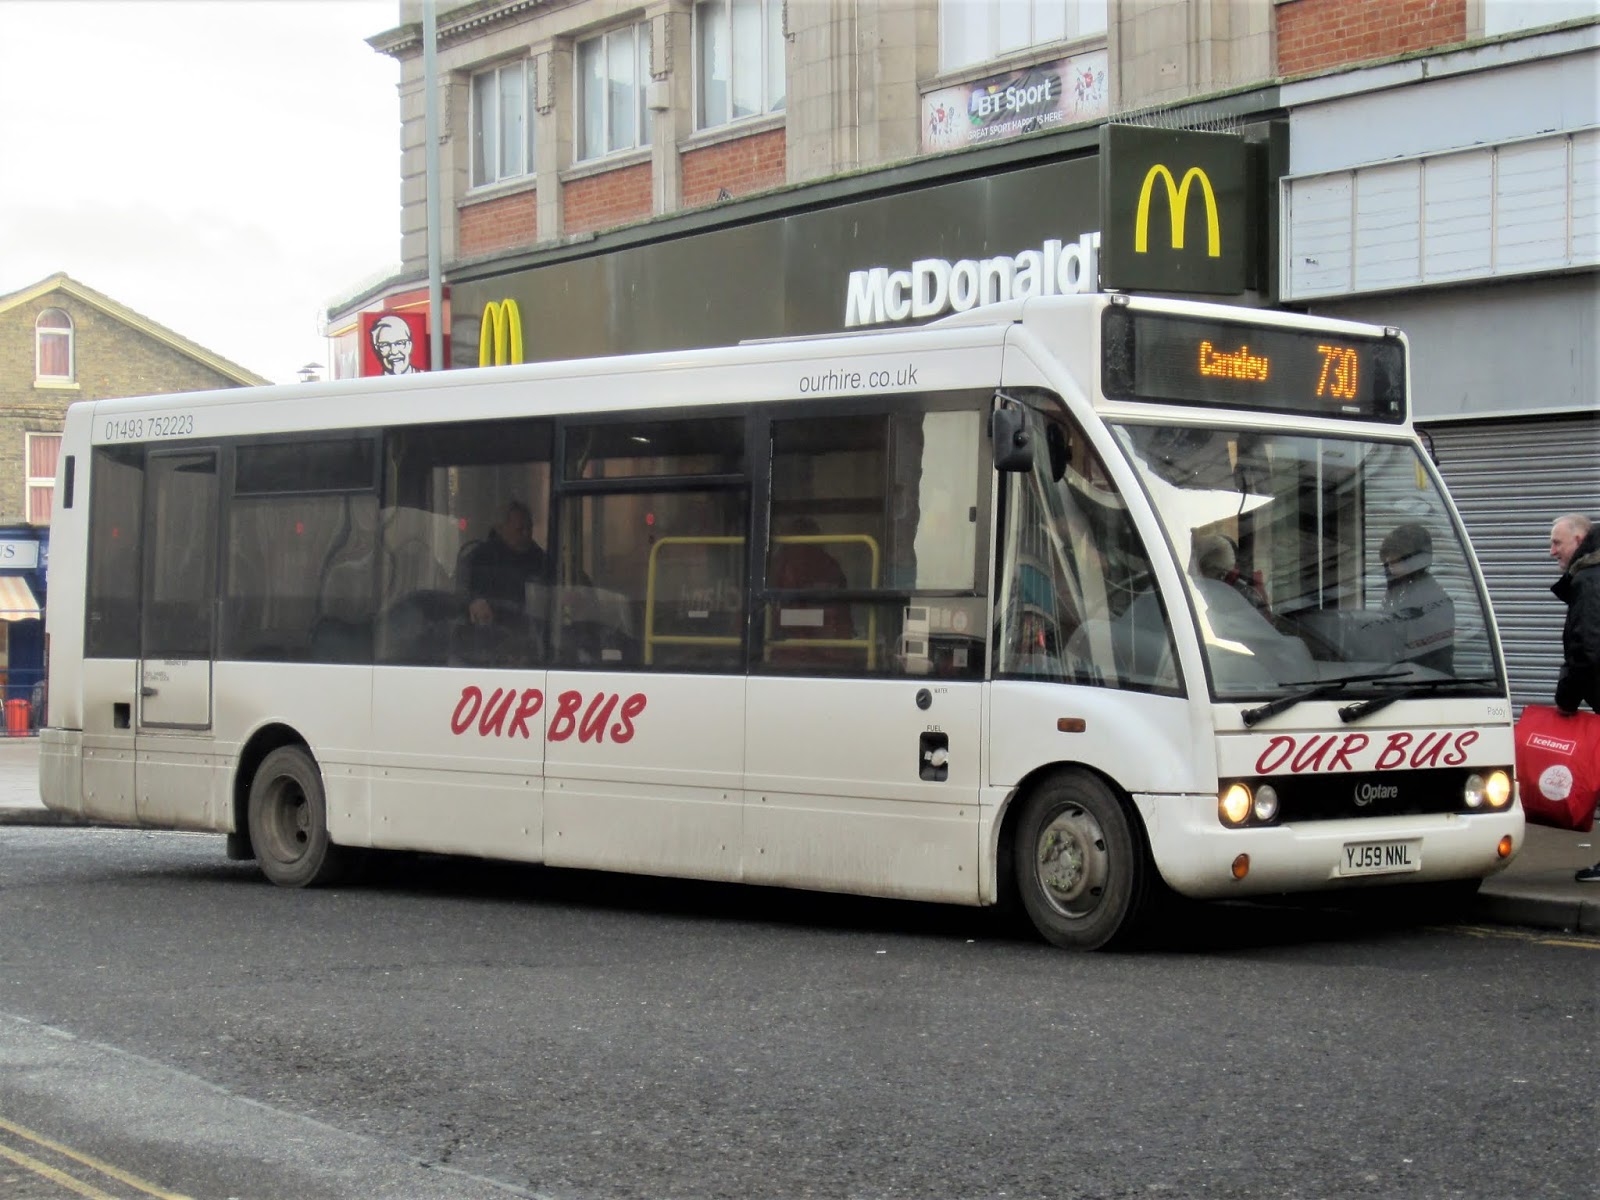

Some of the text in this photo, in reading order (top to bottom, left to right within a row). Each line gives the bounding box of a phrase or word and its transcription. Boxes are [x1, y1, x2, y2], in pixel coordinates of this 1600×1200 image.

[979, 78, 1051, 116] BT Sport
[968, 129, 988, 140] GREAT
[989, 122, 1011, 135] SPORT
[1044, 111, 1063, 123] HERE
[799, 363, 918, 393] ourhire.co.uk
[1199, 341, 1358, 399] Cantley 730
[105, 414, 194, 440] 01493 752223
[451, 685, 648, 744] OUR BUS
[926, 724, 942, 732] FUEL
[1255, 730, 1480, 775] OUR BUS
[1533, 736, 1570, 751] Iceland
[1358, 783, 1398, 804] Optare
[1347, 845, 1412, 868] YJ59 NNL
